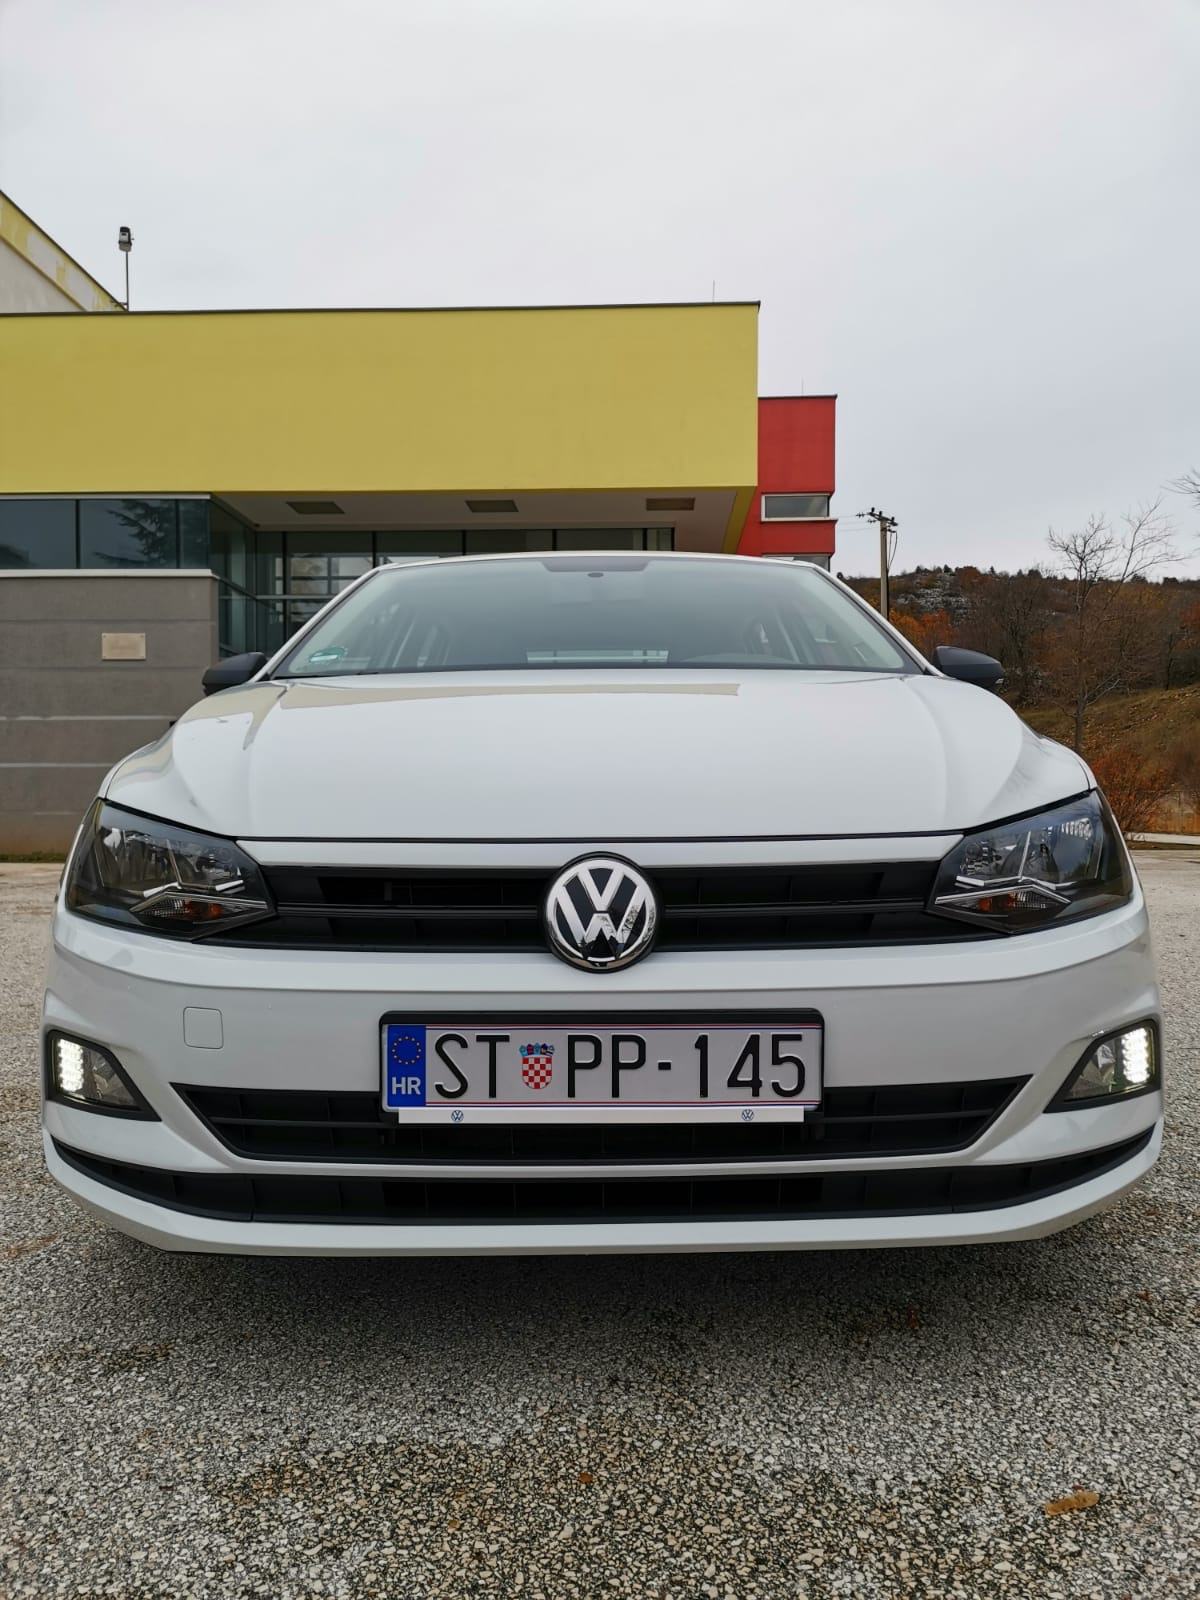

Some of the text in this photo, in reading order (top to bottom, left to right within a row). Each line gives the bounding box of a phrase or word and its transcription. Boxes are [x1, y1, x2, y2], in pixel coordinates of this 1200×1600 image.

[391, 1076, 422, 1095] HR
[434, 1032, 806, 1099] ST PP-145
